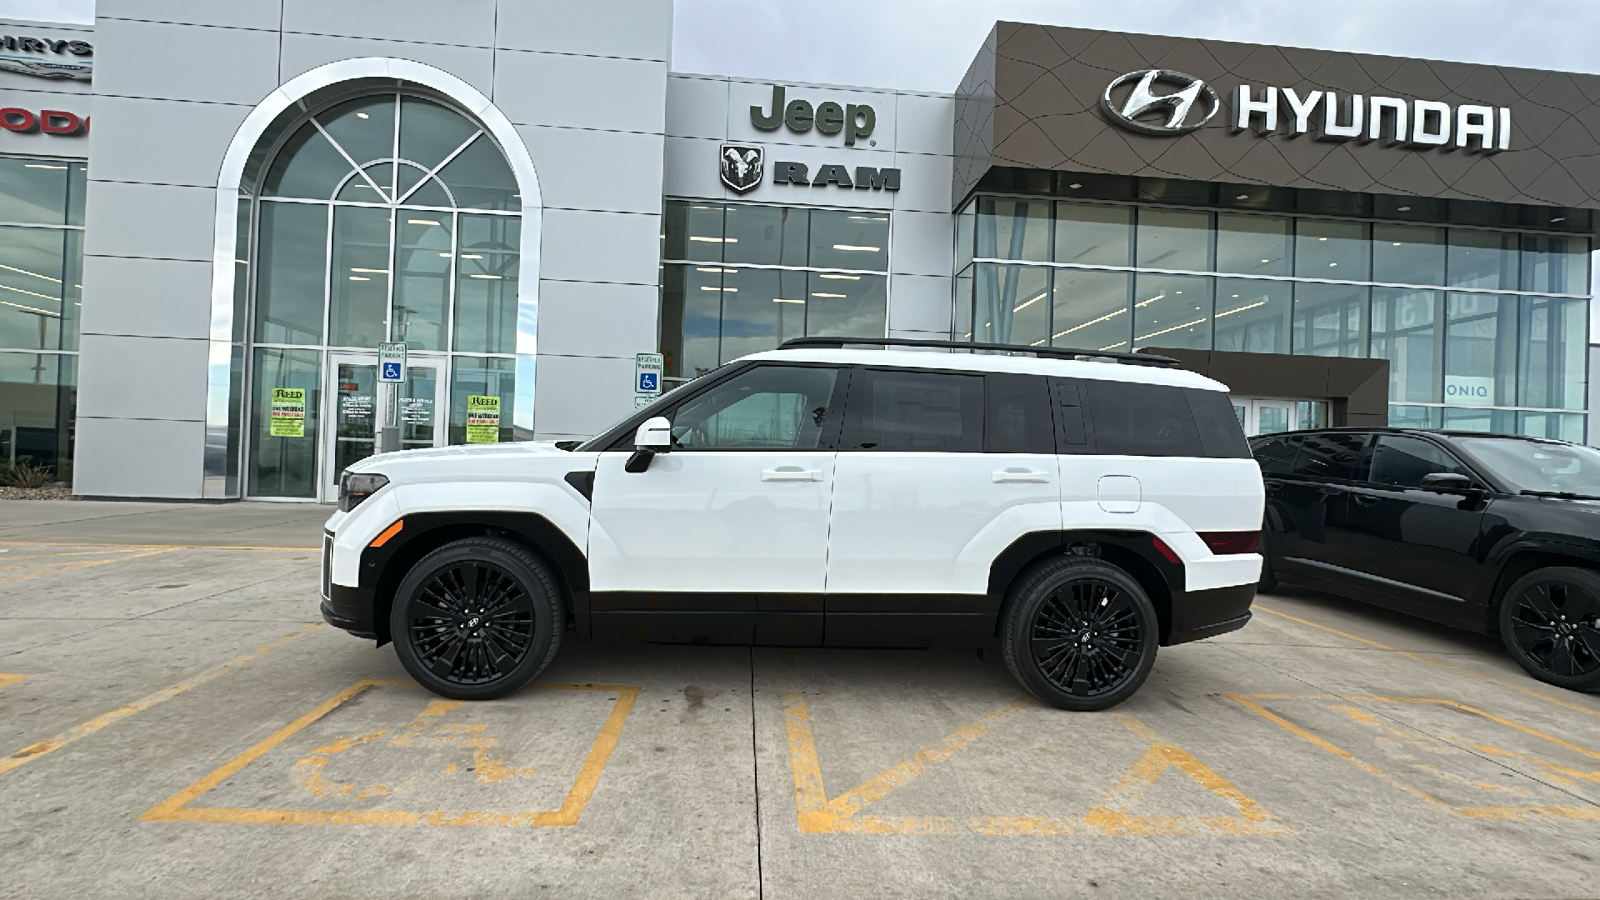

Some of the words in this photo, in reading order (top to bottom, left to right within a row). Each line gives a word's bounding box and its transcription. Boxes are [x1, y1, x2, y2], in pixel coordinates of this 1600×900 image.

[0, 107, 90, 133] OD
[749, 85, 876, 146] Jeep
[1233, 84, 1511, 151] HYUNDAI
[773, 161, 901, 191] RAM
[1446, 384, 1488, 397] ONIQ
